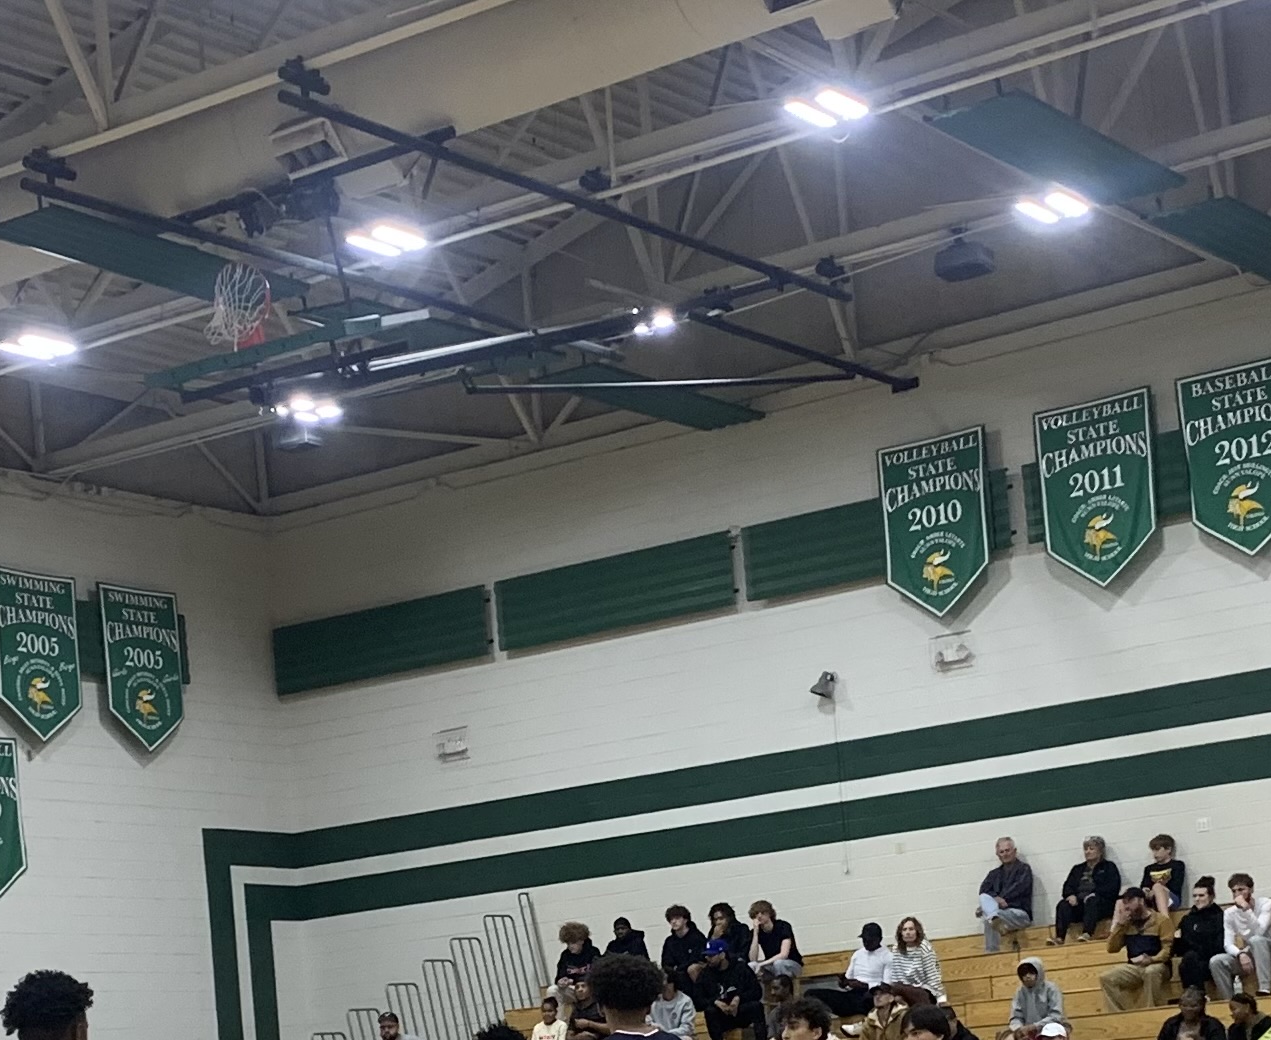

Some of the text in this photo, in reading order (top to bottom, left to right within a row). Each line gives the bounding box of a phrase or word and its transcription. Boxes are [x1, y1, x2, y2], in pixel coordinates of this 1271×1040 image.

[1211, 386, 1268, 411] STATE
[1041, 396, 1143, 431] VOLLEYBALL
[1067, 419, 1120, 444] STATE
[884, 434, 977, 467] VOLLEYBALL
[1042, 430, 1147, 479] CHAMPIONS
[908, 457, 957, 480] STATE
[1068, 464, 1125, 498] 2011
[885, 467, 981, 513] CHAMPIONS
[908, 499, 962, 532] 2010
[0, 574, 65, 594] SWIMMING
[15, 593, 55, 610] STATE
[108, 591, 168, 609] SWIMMING
[121, 608, 159, 624] STATE
[16, 632, 60, 657] 2005
[106, 621, 178, 652] CHAMPIONS
[124, 647, 163, 670] 2005
